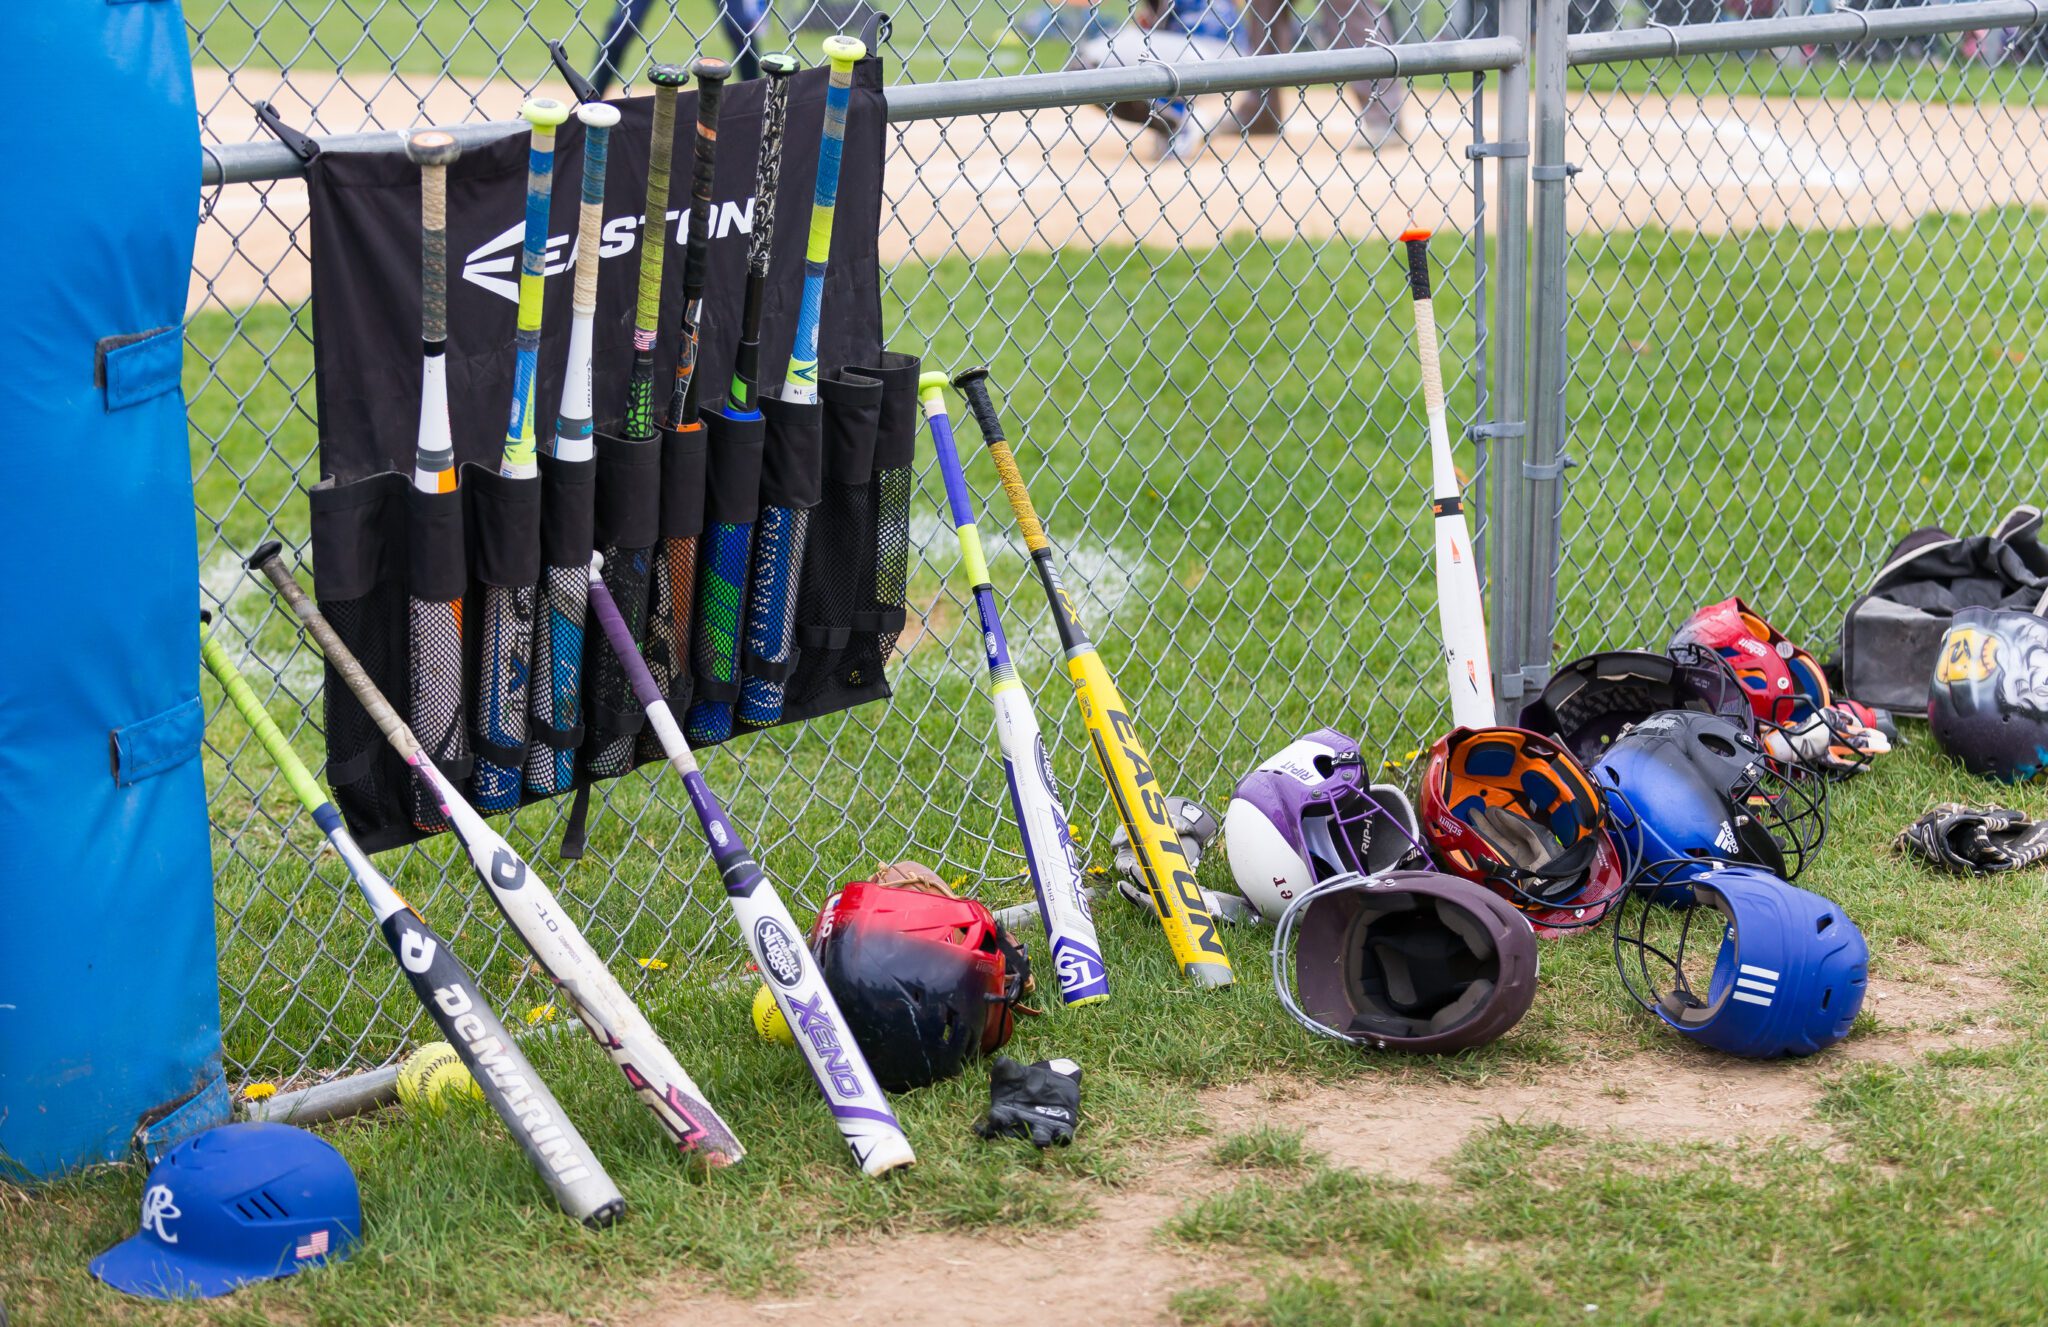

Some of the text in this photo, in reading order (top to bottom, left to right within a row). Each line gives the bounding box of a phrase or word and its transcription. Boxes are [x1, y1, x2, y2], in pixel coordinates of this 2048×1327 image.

[543, 197, 756, 277] ESON
[1737, 636, 1768, 659] schutt
[1280, 760, 1315, 782] RIP-IT
[1106, 709, 1226, 957] EASTON
[1360, 809, 1373, 855] RIP-I
[1438, 814, 1463, 837] schutt
[1719, 820, 1739, 854] adidas
[534, 902, 560, 944] -10
[1166, 882, 1199, 954] FASTPITCH
[758, 923, 798, 983] Slugger
[776, 934, 801, 976] LOUISVILLE
[784, 991, 864, 1100] XENO
[433, 983, 593, 1186] DeMARINI
